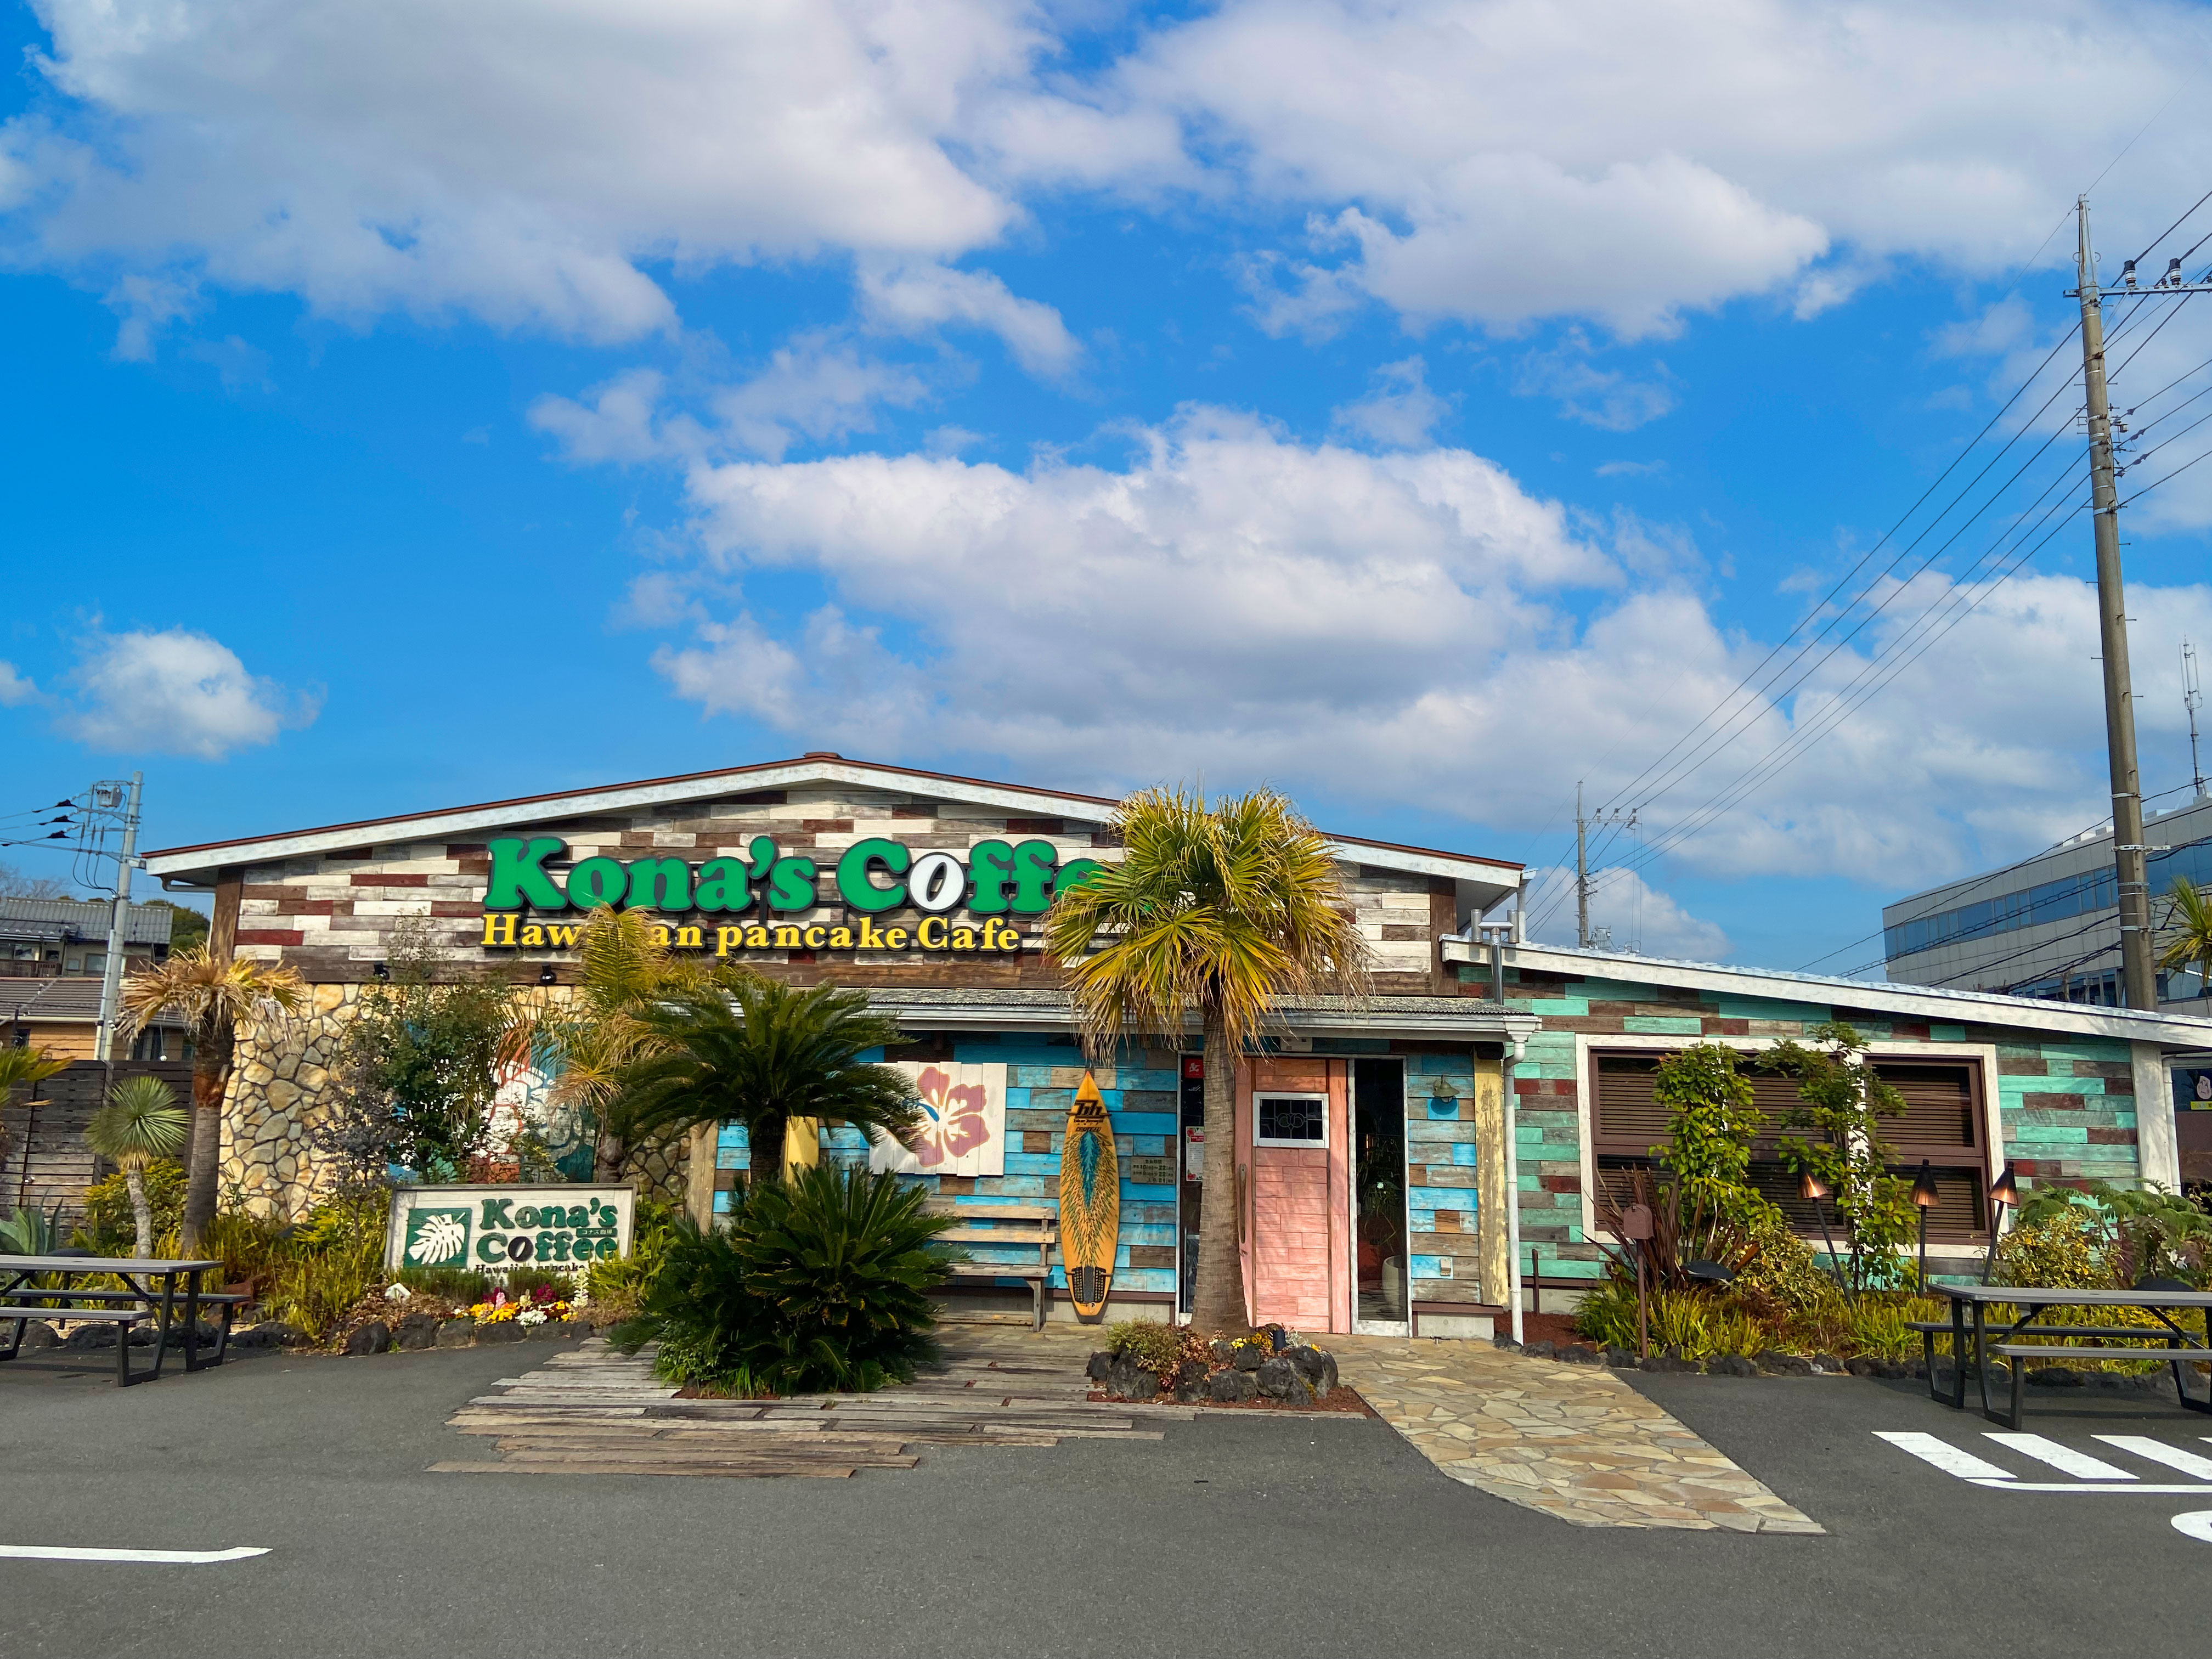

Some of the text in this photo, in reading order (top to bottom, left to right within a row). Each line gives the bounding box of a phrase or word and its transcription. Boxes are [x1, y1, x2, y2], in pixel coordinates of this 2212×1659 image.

[482, 836, 1152, 914] Kona's Coffe
[481, 913, 1020, 958] Hawan pancake Cafe
[479, 1197, 618, 1229] Kona's
[476, 1231, 618, 1263] Coffee
[476, 1263, 533, 1274] Hawaii
